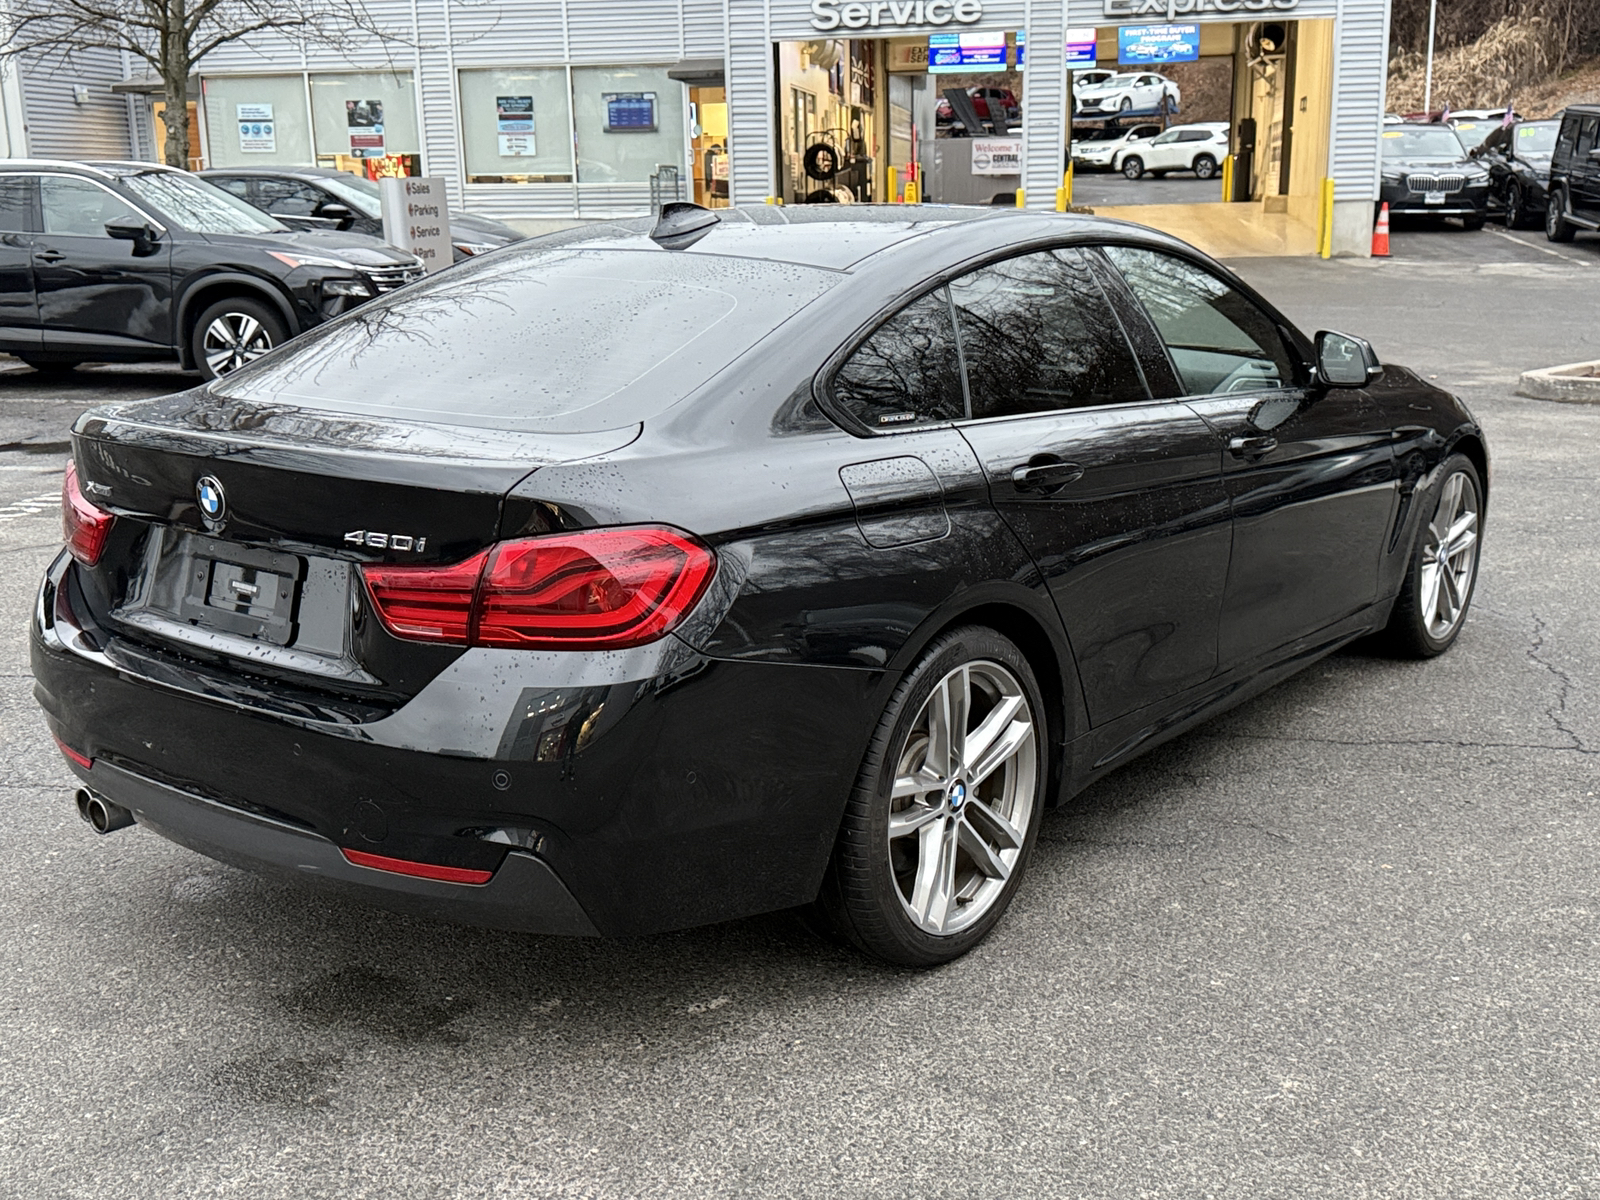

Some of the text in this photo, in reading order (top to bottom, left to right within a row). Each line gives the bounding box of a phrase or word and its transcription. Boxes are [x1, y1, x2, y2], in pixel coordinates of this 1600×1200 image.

[809, 0, 983, 31] Service
[1168, 25, 1196, 35] BUYER
[974, 143, 1013, 153] Welcome
[992, 154, 1019, 163] CENTRAL
[411, 182, 430, 195] Sales
[413, 204, 439, 218] Parking
[416, 226, 441, 238] Service
[418, 247, 436, 259] Parts
